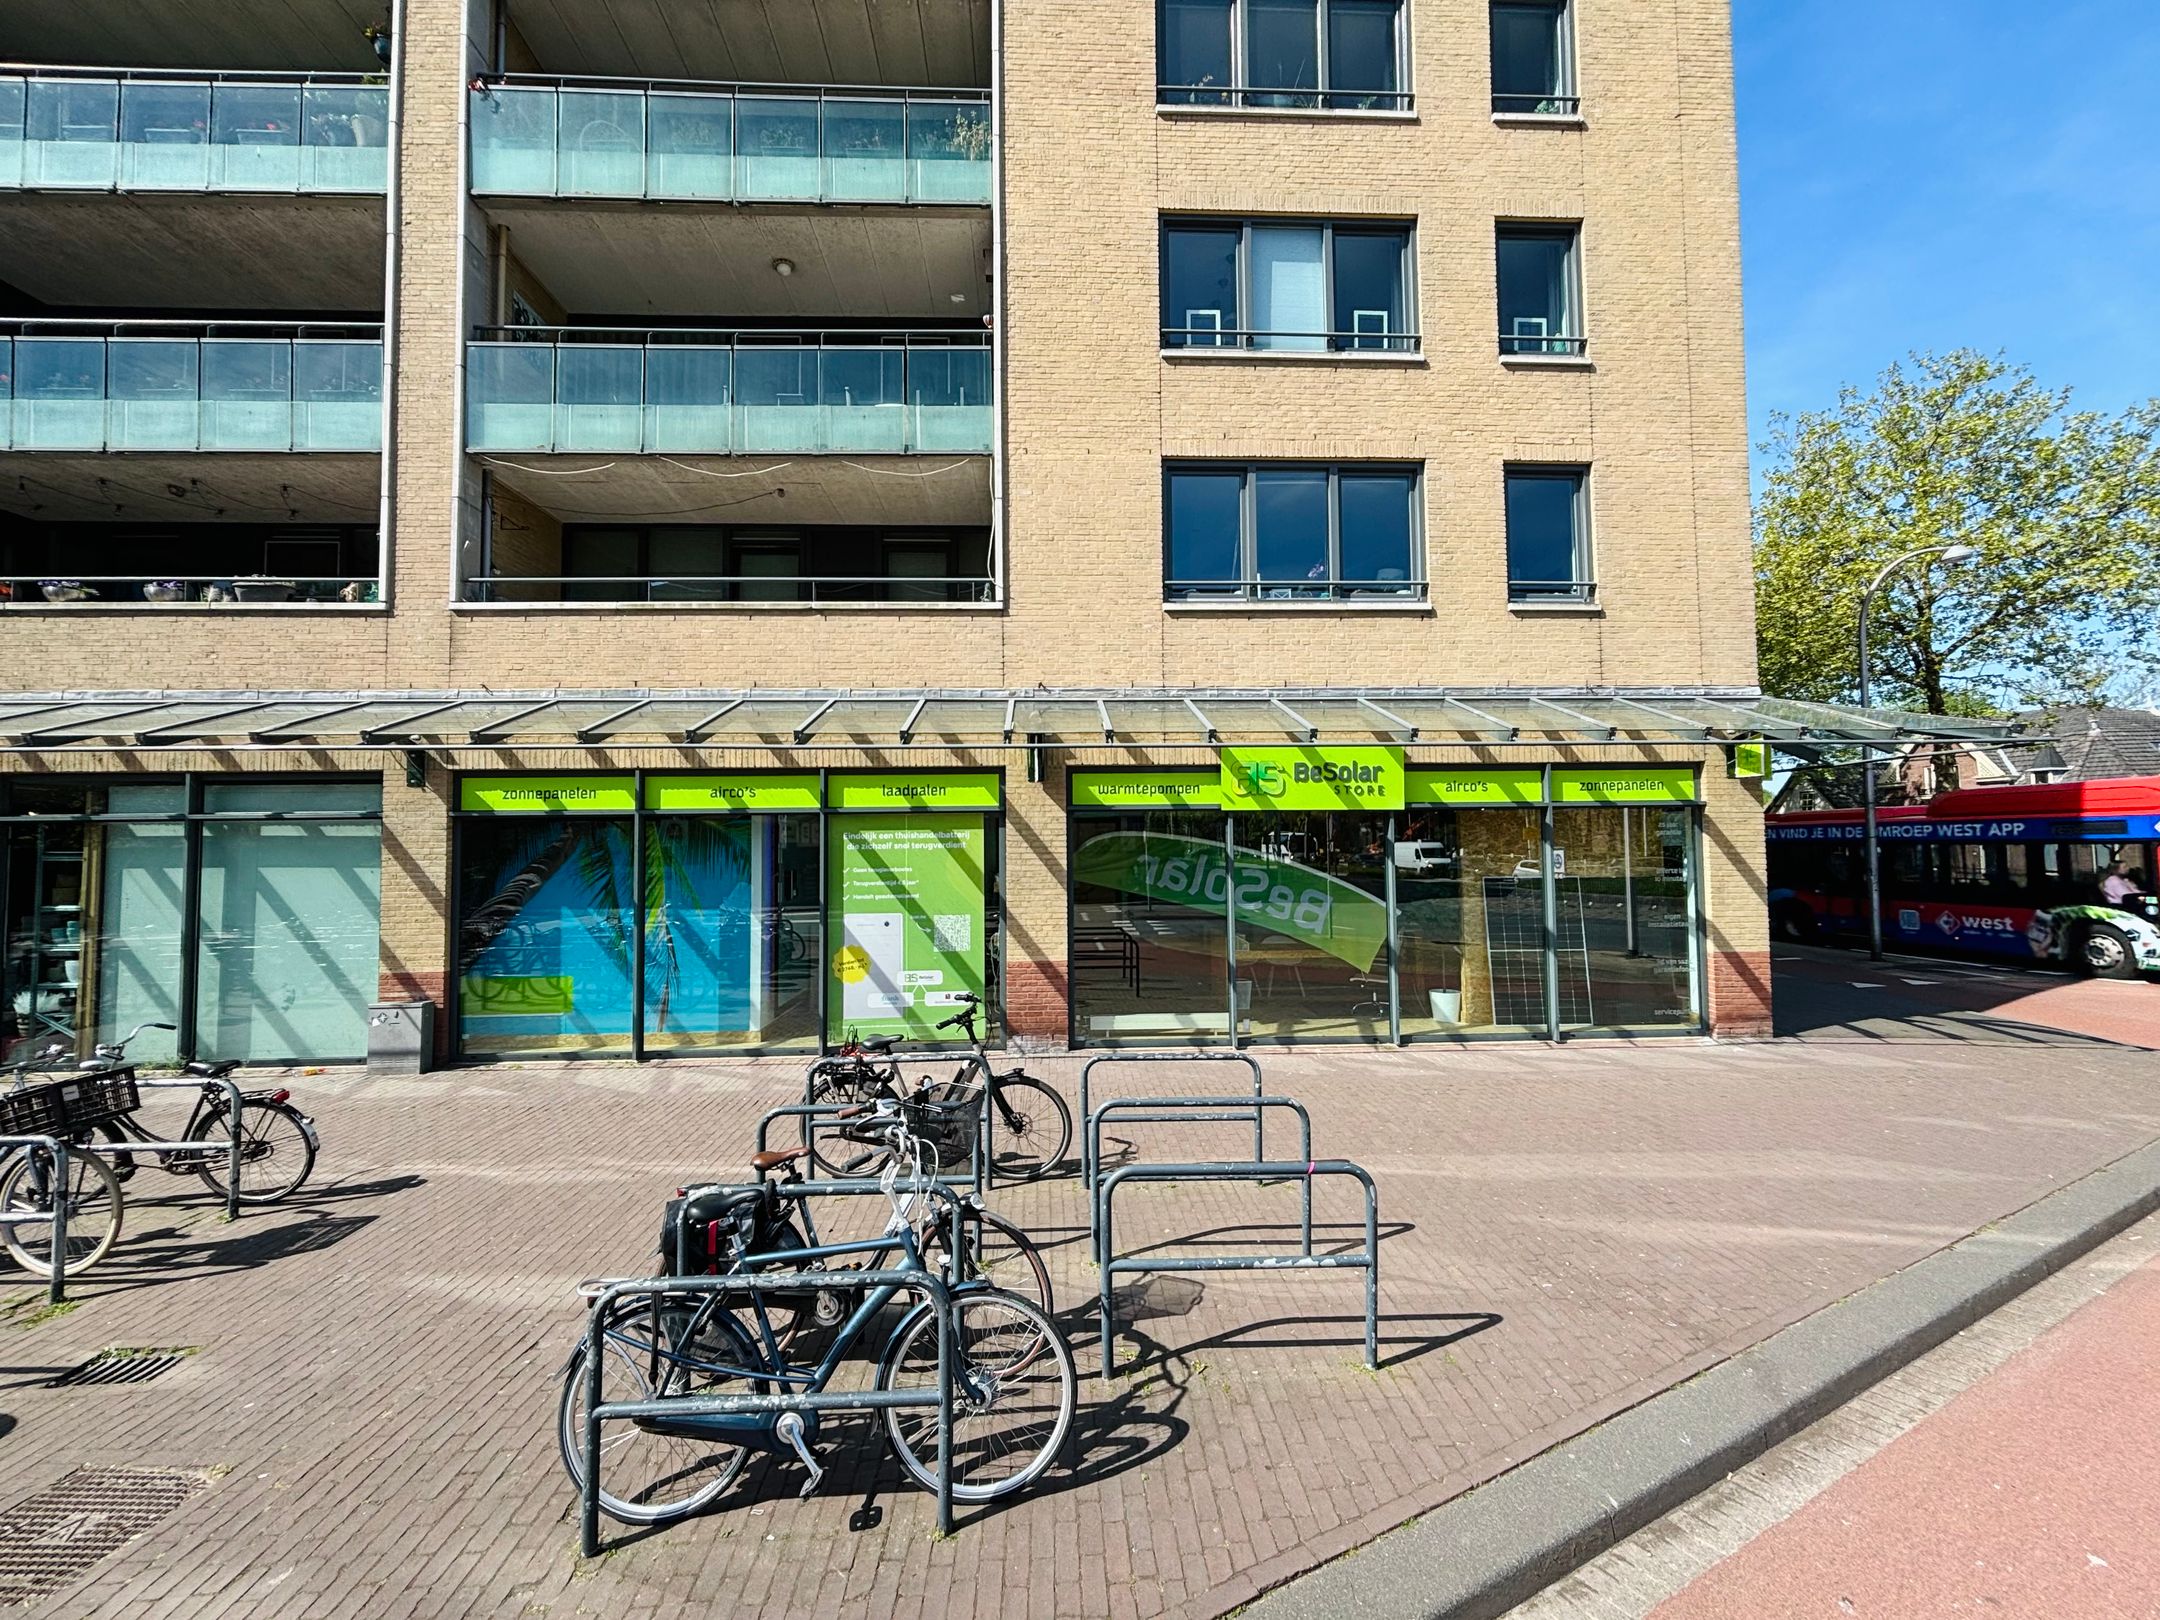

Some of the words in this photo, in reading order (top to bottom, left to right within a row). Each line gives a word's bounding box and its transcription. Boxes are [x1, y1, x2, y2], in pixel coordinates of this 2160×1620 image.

[1294, 760, 1385, 783] BeSolar
[709, 785, 757, 799] airco's
[881, 783, 947, 799] laadpalen
[1098, 783, 1200, 797] warmtepompen
[1334, 785, 1386, 797] STORE
[1445, 780, 1489, 793] airco's
[1579, 779, 1665, 794] zonnepanelen
[502, 786, 597, 802] zonnepanelen
[842, 832, 877, 841] Eindelijk
[894, 831, 971, 840] thuishandelbatterij
[1778, 827, 1809, 839] VIND
[1810, 827, 1825, 839] JE
[1828, 827, 1842, 838] IN
[1844, 826, 1864, 838] DE
[1875, 824, 1934, 838] MROEP
[1936, 823, 1984, 837] WEST
[1987, 822, 2026, 837] APP
[861, 842, 893, 850] zichzelf
[911, 841, 967, 850] terugverdient
[1961, 916, 2015, 931] west
